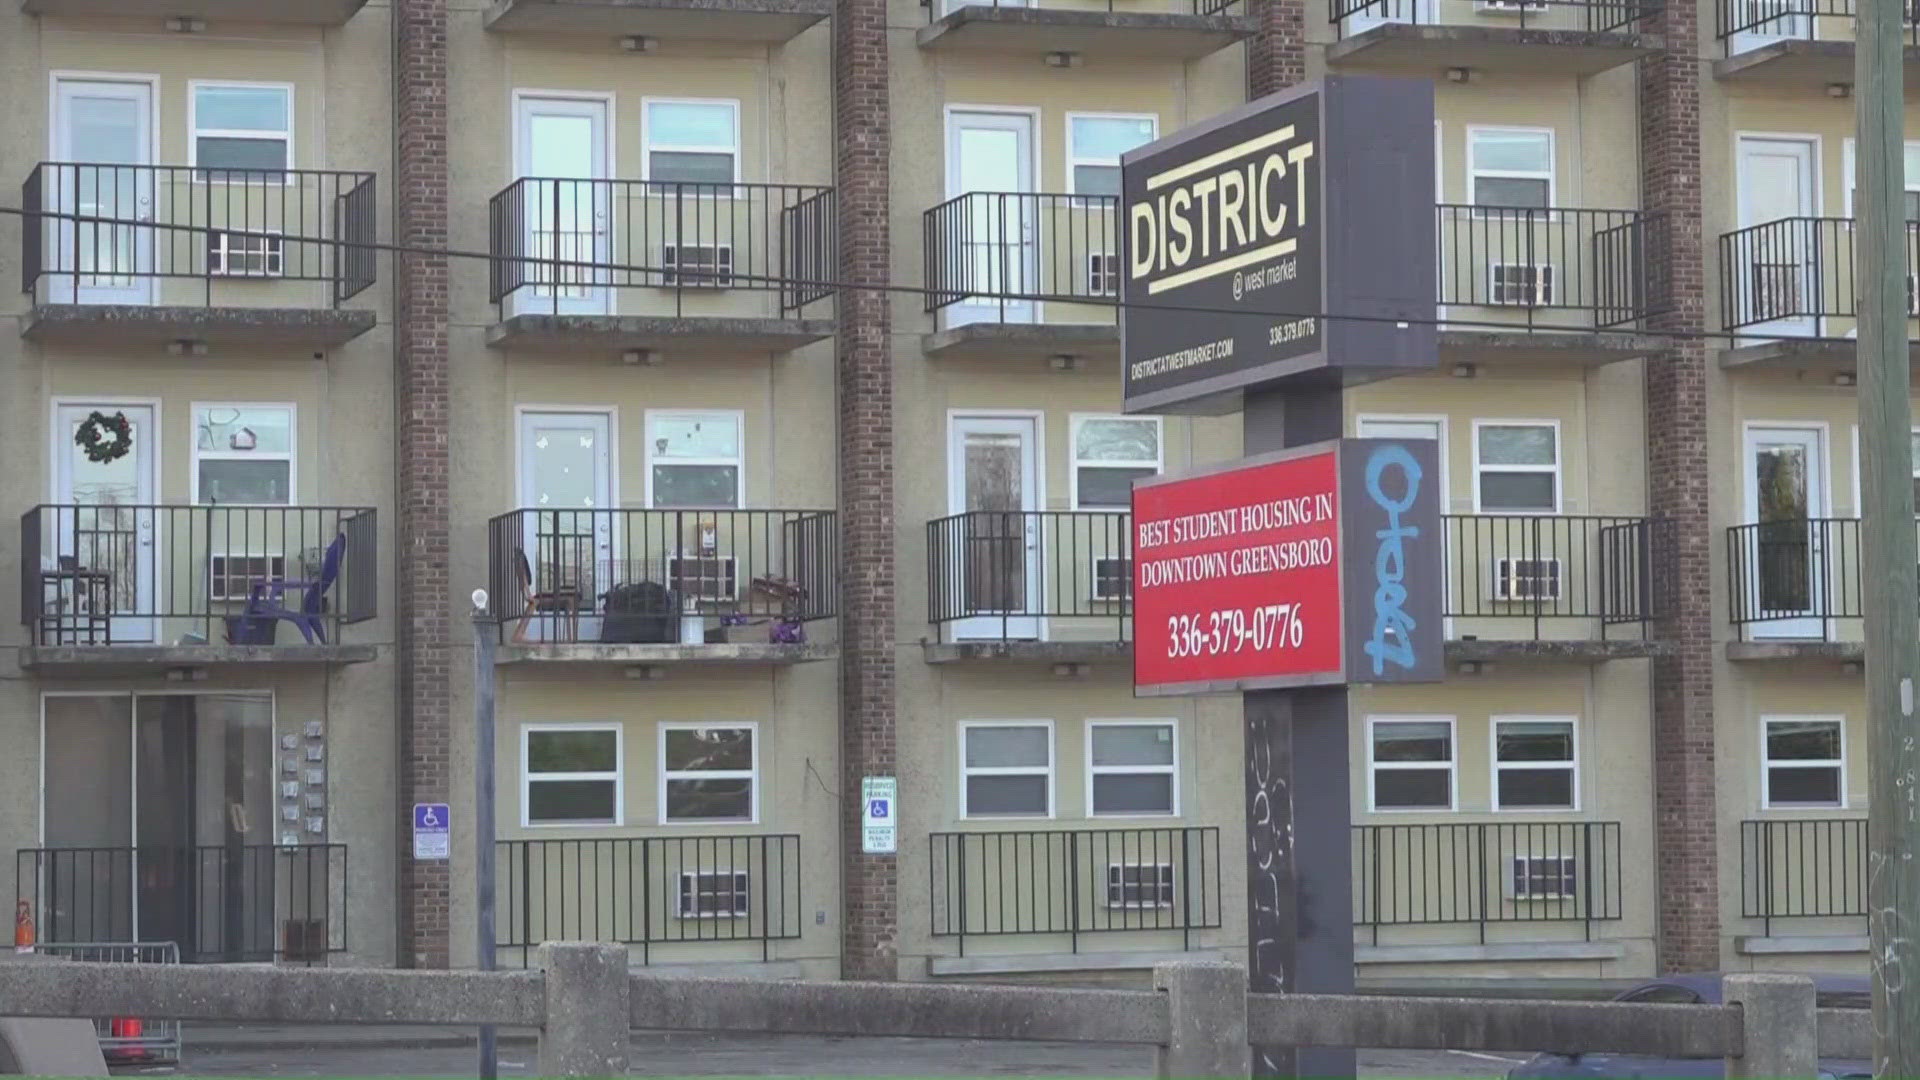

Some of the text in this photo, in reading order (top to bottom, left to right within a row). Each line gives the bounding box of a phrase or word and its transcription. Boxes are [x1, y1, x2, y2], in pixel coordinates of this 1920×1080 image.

[1131, 141, 1313, 279] DISTRICT
[1232, 259, 1297, 300] @ west market
[1269, 317, 1315, 345] 336.379.0776
[1131, 338, 1233, 381] DISTRICTATWESTMARKET.COM
[1139, 492, 1333, 548] BEST STUDENT HOUSING IN
[1141, 537, 1332, 587] DOWNTOWN GREENSBORO
[1167, 602, 1303, 658] 336-379-0776
